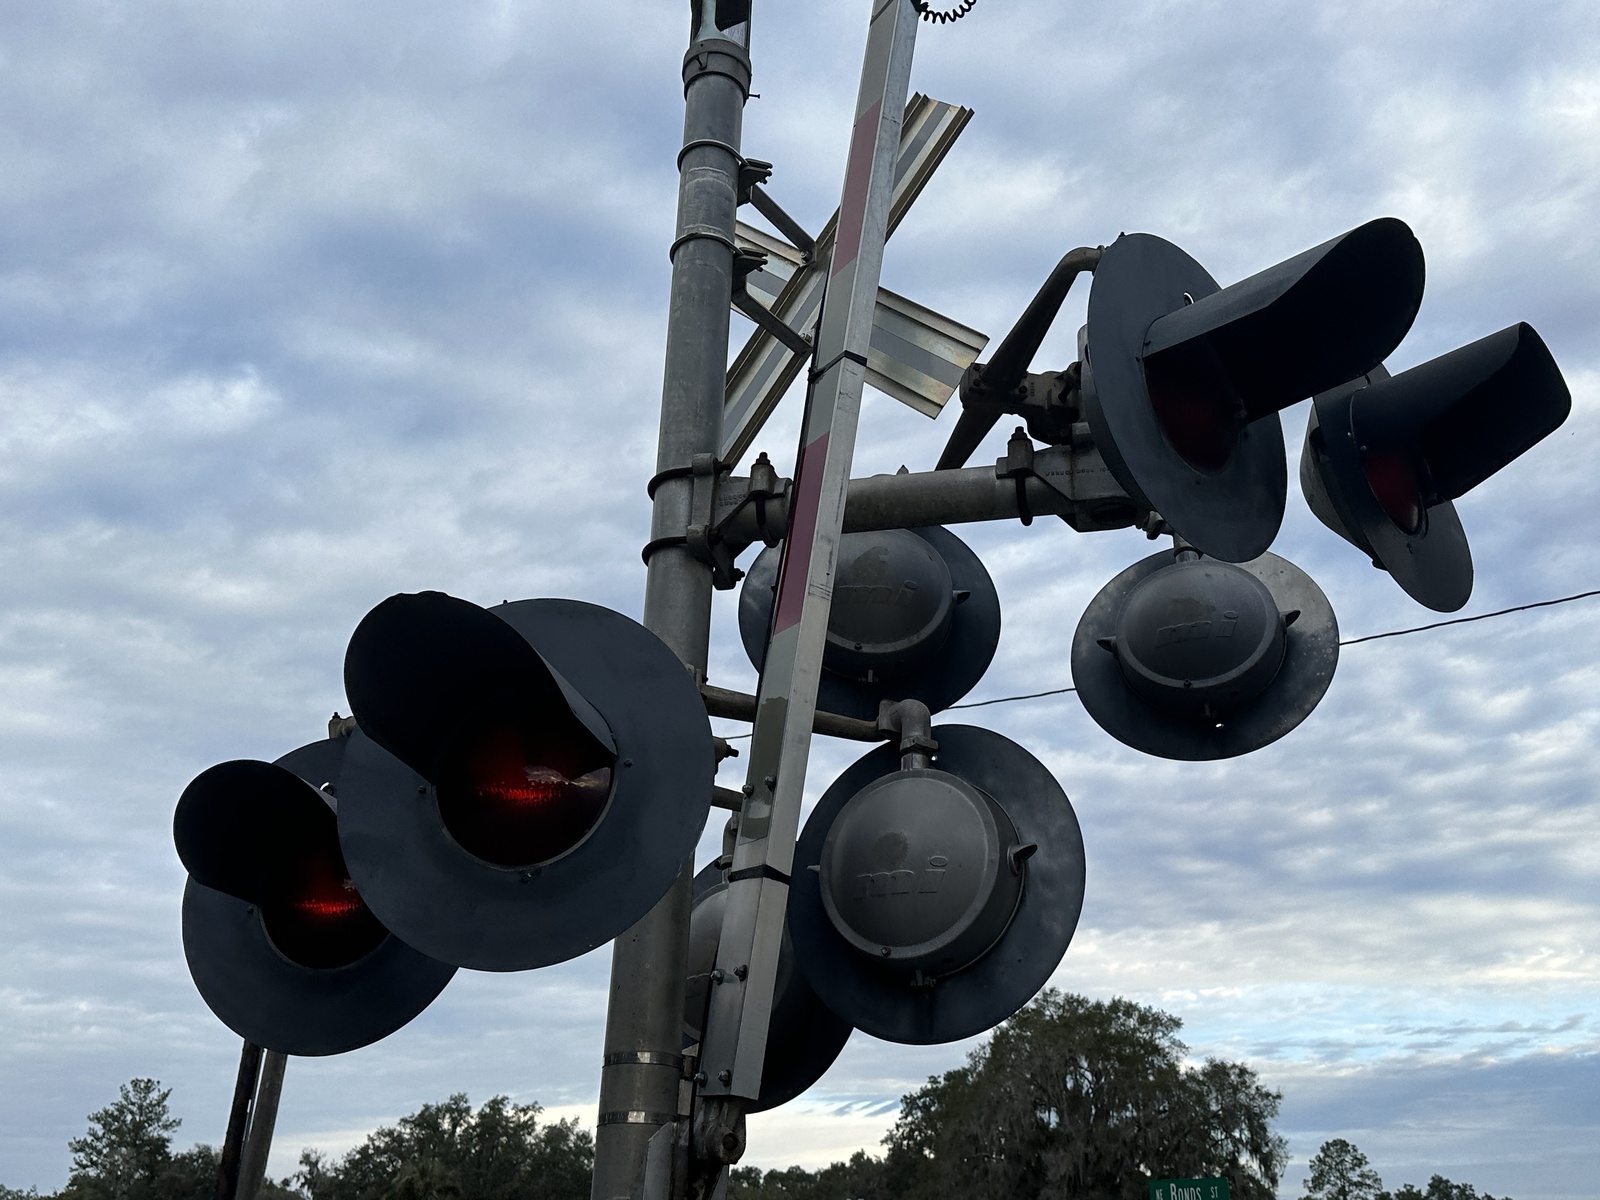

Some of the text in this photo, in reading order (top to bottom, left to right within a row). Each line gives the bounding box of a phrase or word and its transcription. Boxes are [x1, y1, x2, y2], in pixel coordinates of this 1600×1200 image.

[1155, 1183, 1218, 1200] NE BONDS ST
